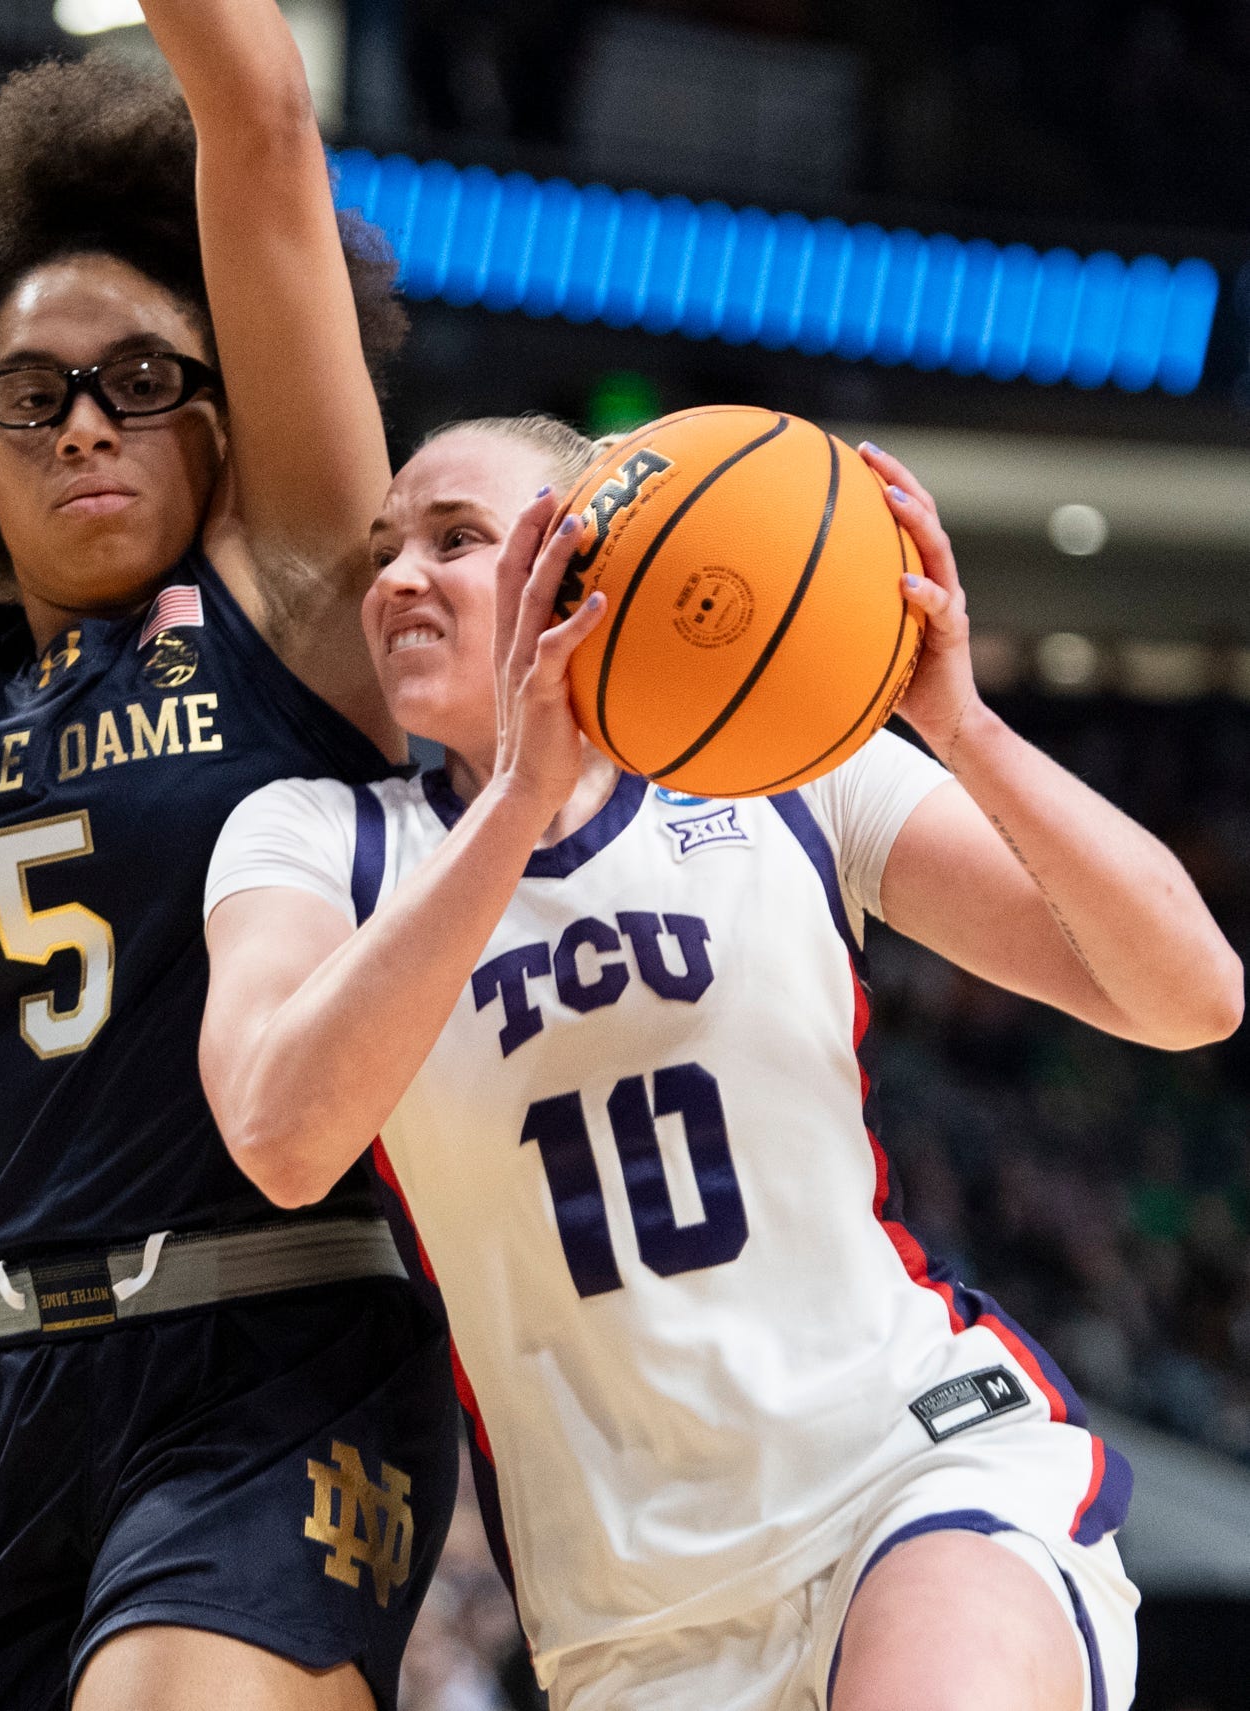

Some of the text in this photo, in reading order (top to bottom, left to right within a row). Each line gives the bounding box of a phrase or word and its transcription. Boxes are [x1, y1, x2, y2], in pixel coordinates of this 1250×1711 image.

[640, 469, 683, 504] BALL
[58, 692, 224, 784] DAME
[470, 910, 715, 1059] TCU
[519, 1061, 749, 1299] 10
[40, 1286, 110, 1309] NOTRE DAME
[986, 1376, 1012, 1400] M
